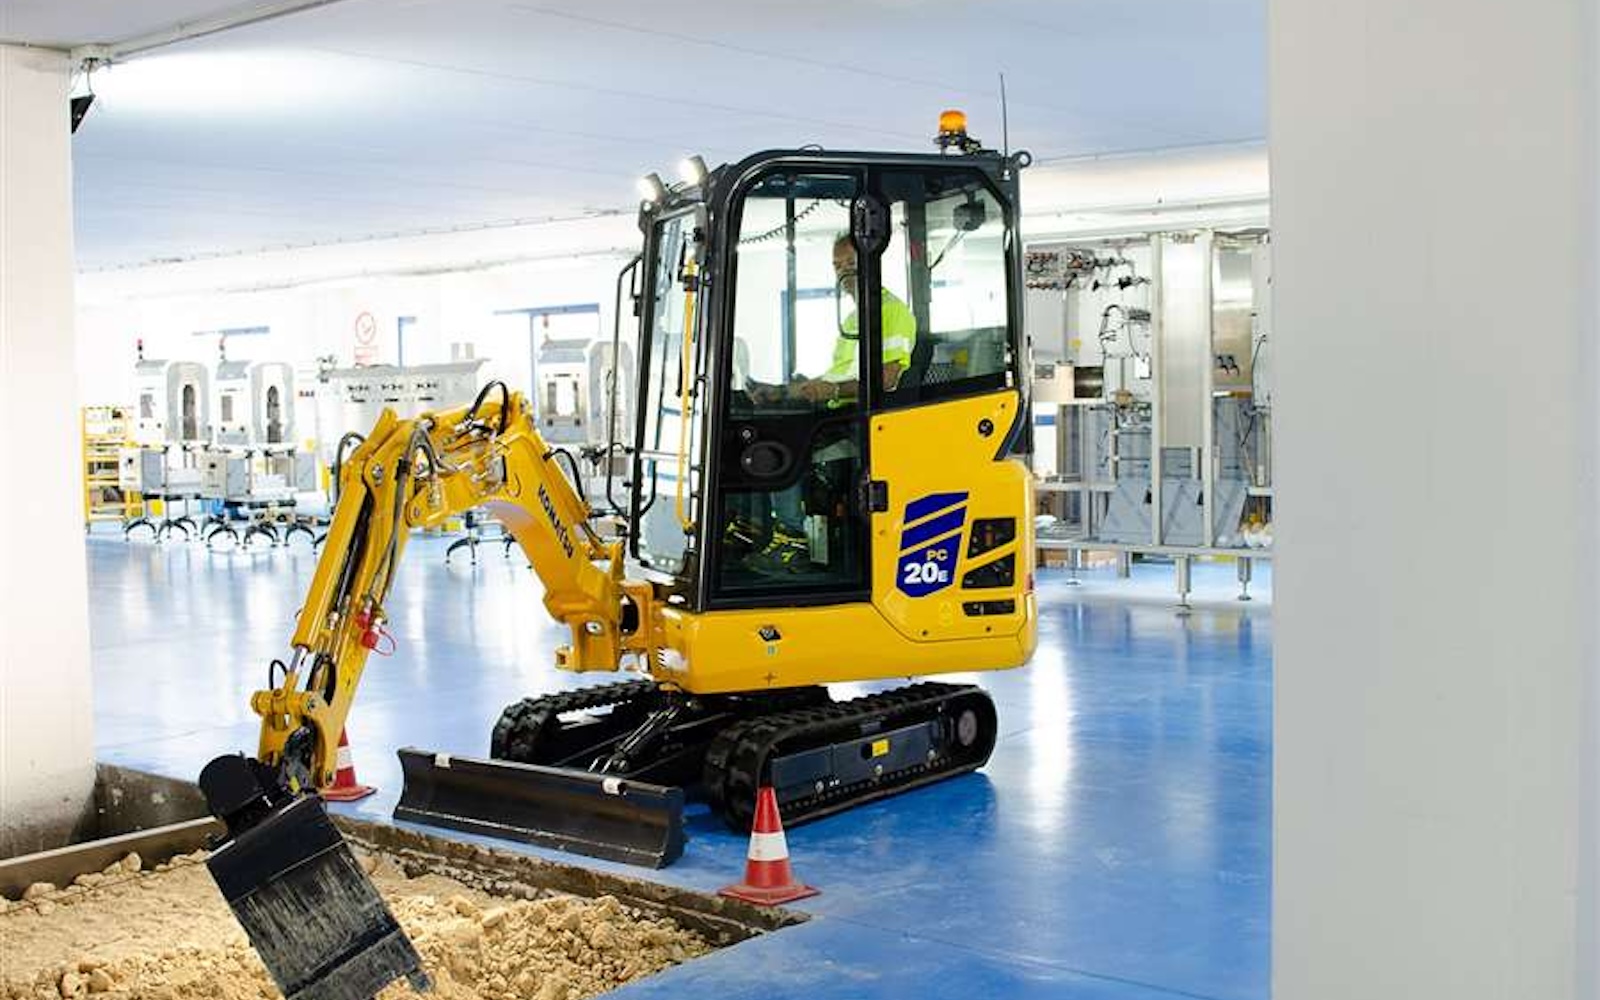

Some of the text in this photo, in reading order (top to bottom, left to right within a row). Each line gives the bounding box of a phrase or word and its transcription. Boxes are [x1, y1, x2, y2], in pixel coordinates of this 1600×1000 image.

[538, 484, 574, 559] KOMATSU
[926, 548, 949, 561] PC
[903, 561, 949, 585] 20E
